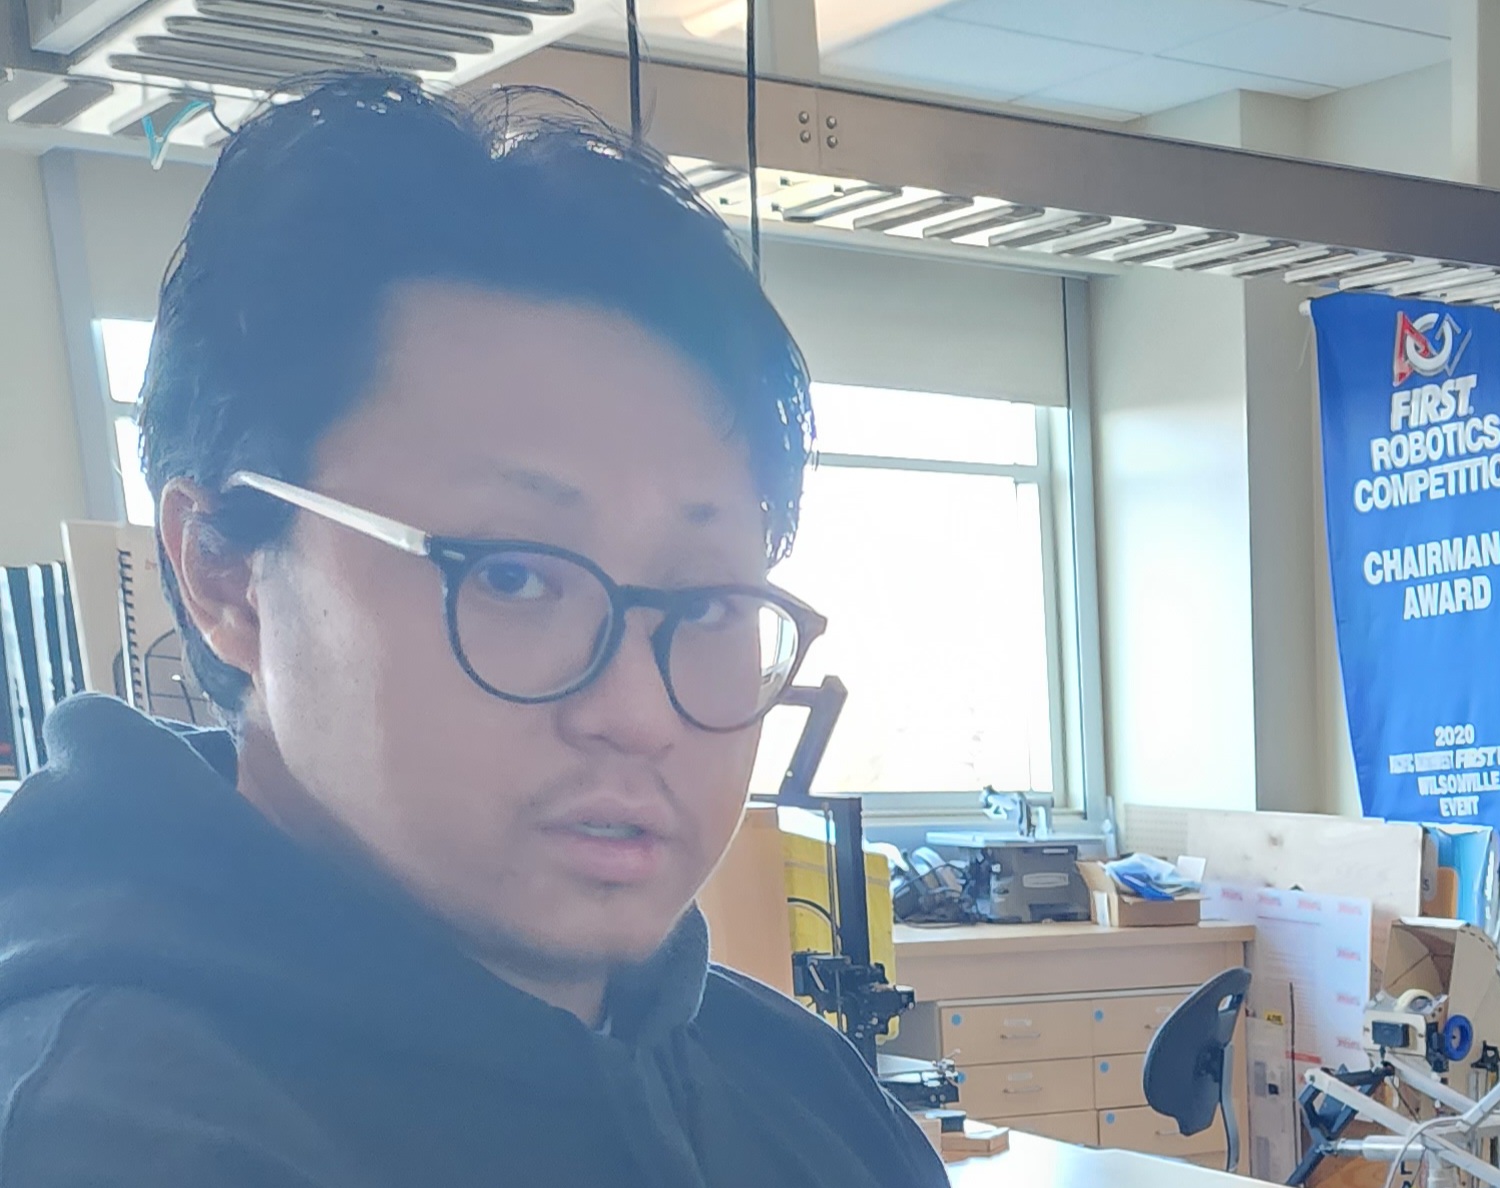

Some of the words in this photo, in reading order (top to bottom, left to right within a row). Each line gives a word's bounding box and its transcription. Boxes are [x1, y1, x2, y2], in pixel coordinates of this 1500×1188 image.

[1402, 575, 1493, 621] AWARD
[1434, 723, 1475, 747] 2020
[1439, 796, 1480, 818] EVENT
